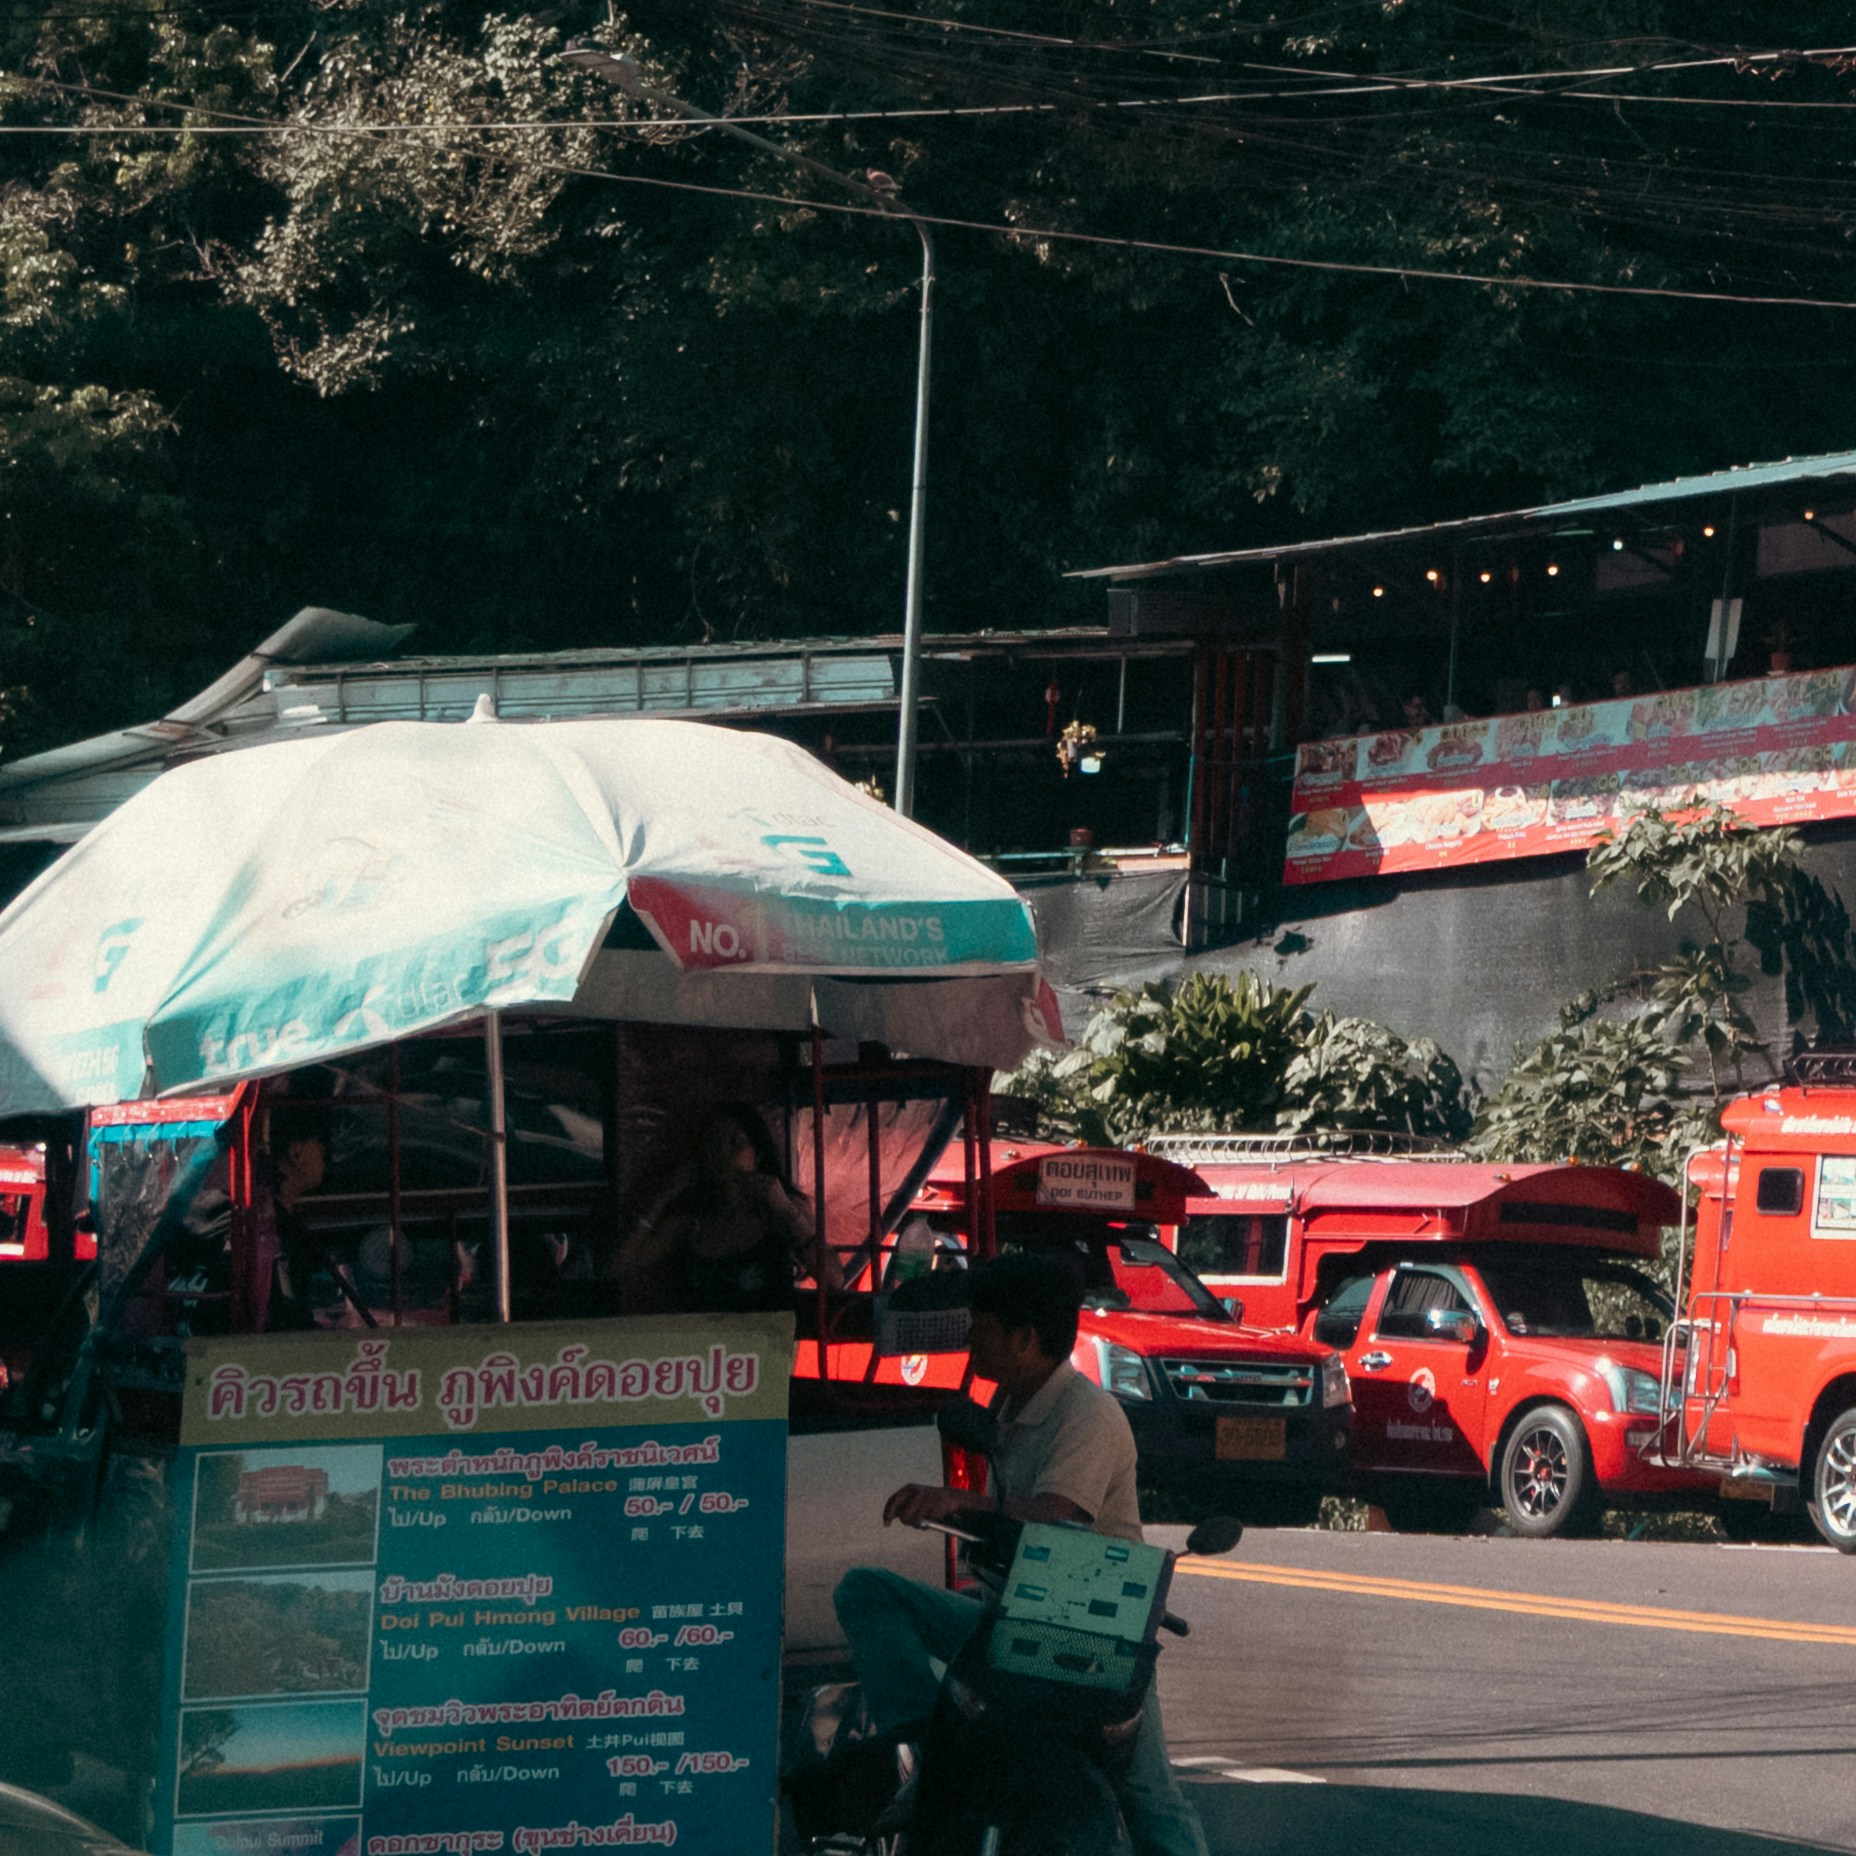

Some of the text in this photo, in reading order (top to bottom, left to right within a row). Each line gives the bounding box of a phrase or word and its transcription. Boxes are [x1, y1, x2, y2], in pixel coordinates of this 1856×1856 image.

[689, 919, 747, 960] NO.
[200, 1019, 310, 1076] true
[1045, 1160, 1132, 1189] ดอยสุเทพ
[207, 1339, 761, 1432] คิวรถขึ้น ภูพิงค์ดอยปุย
[387, 1434, 722, 1480] พระตำหนักภูพิงค์ราชนิเวศน์
[389, 1478, 618, 1502] The Bhubing Palace
[387, 1503, 572, 1529] ไป/Up กลับ/Down
[623, 1495, 675, 1517] 50.-
[699, 1493, 750, 1514] 50.-
[670, 1525, 705, 1541] 下去
[380, 1604, 641, 1631] Doi Pui Hmong Village
[379, 1636, 566, 1662] ไป/Up กลับ/Down
[618, 1625, 669, 1650] 60.-
[665, 1656, 701, 1673] 下去
[373, 1689, 686, 1738] จุดชมวิวพระอาทิตย์ตกดิน
[373, 1734, 575, 1759] Viewpoint Sunset
[372, 1761, 561, 1788] ไป/Up กลับ/Down
[606, 1753, 670, 1778] 150.-
[658, 1779, 694, 1796] 下去
[267, 1829, 325, 1847] Summit
